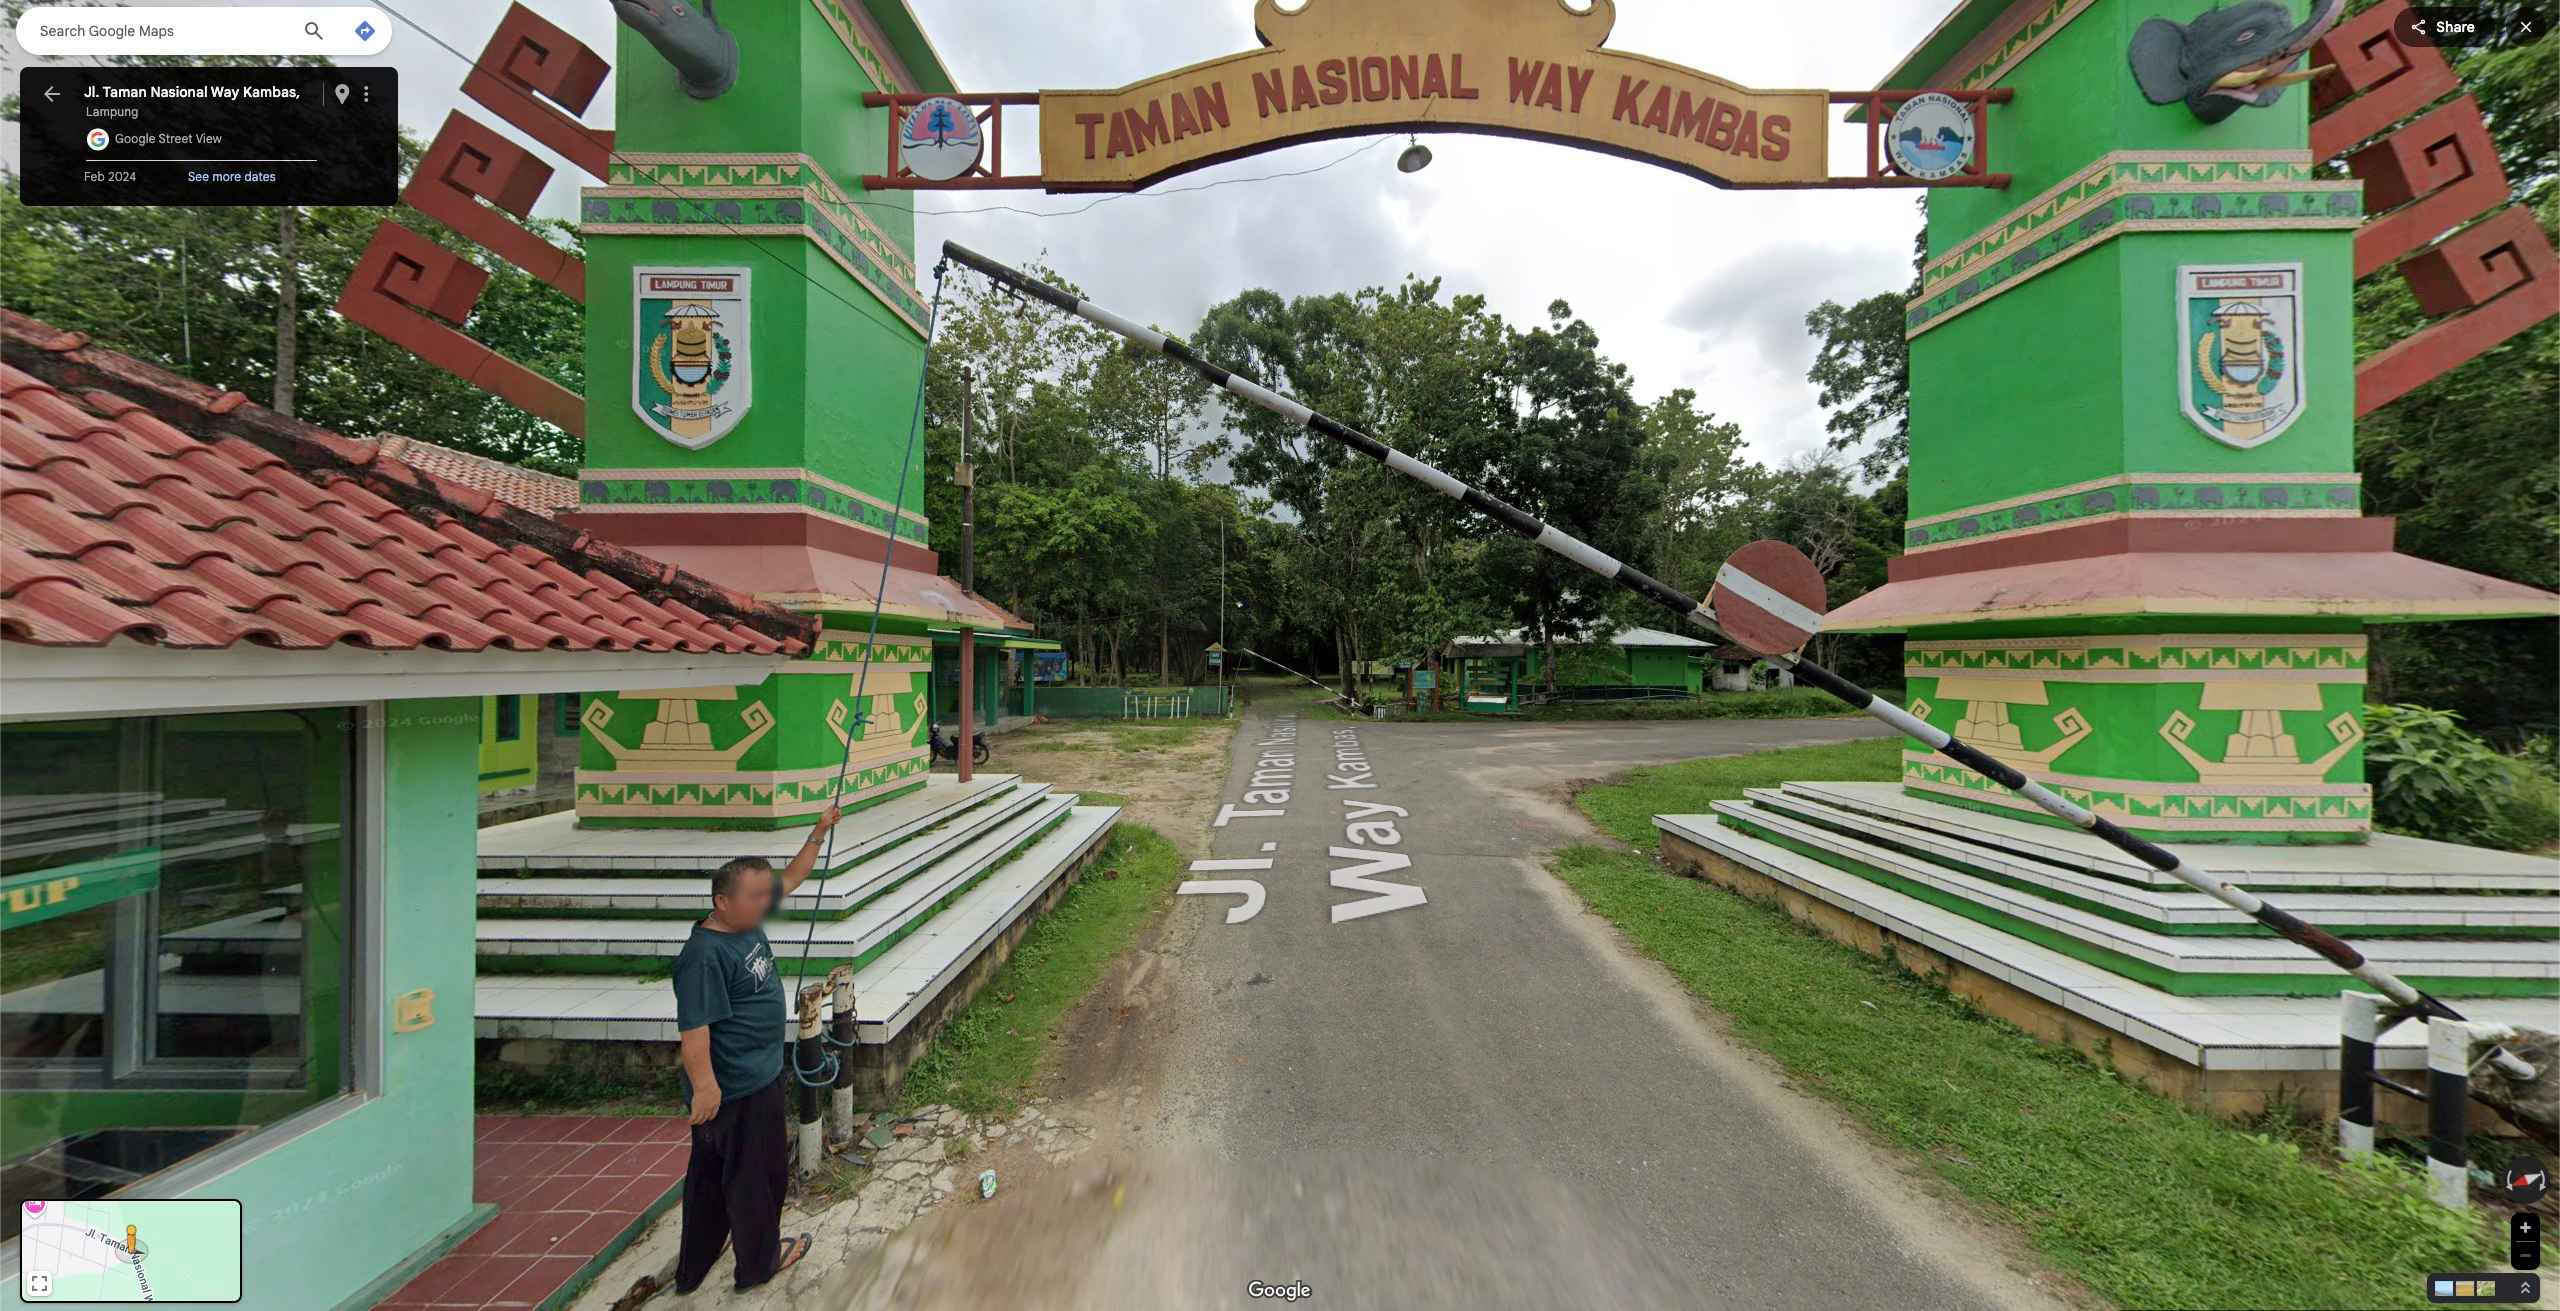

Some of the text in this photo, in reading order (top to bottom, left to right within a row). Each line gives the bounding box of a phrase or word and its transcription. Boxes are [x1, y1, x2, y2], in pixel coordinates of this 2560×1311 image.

[1075, 54, 1792, 162] TAMAN NASIONAL WAY KAMBAS
[655, 280, 728, 290] LAMPUNG TIMUR
[0, 876, 80, 913] UP
